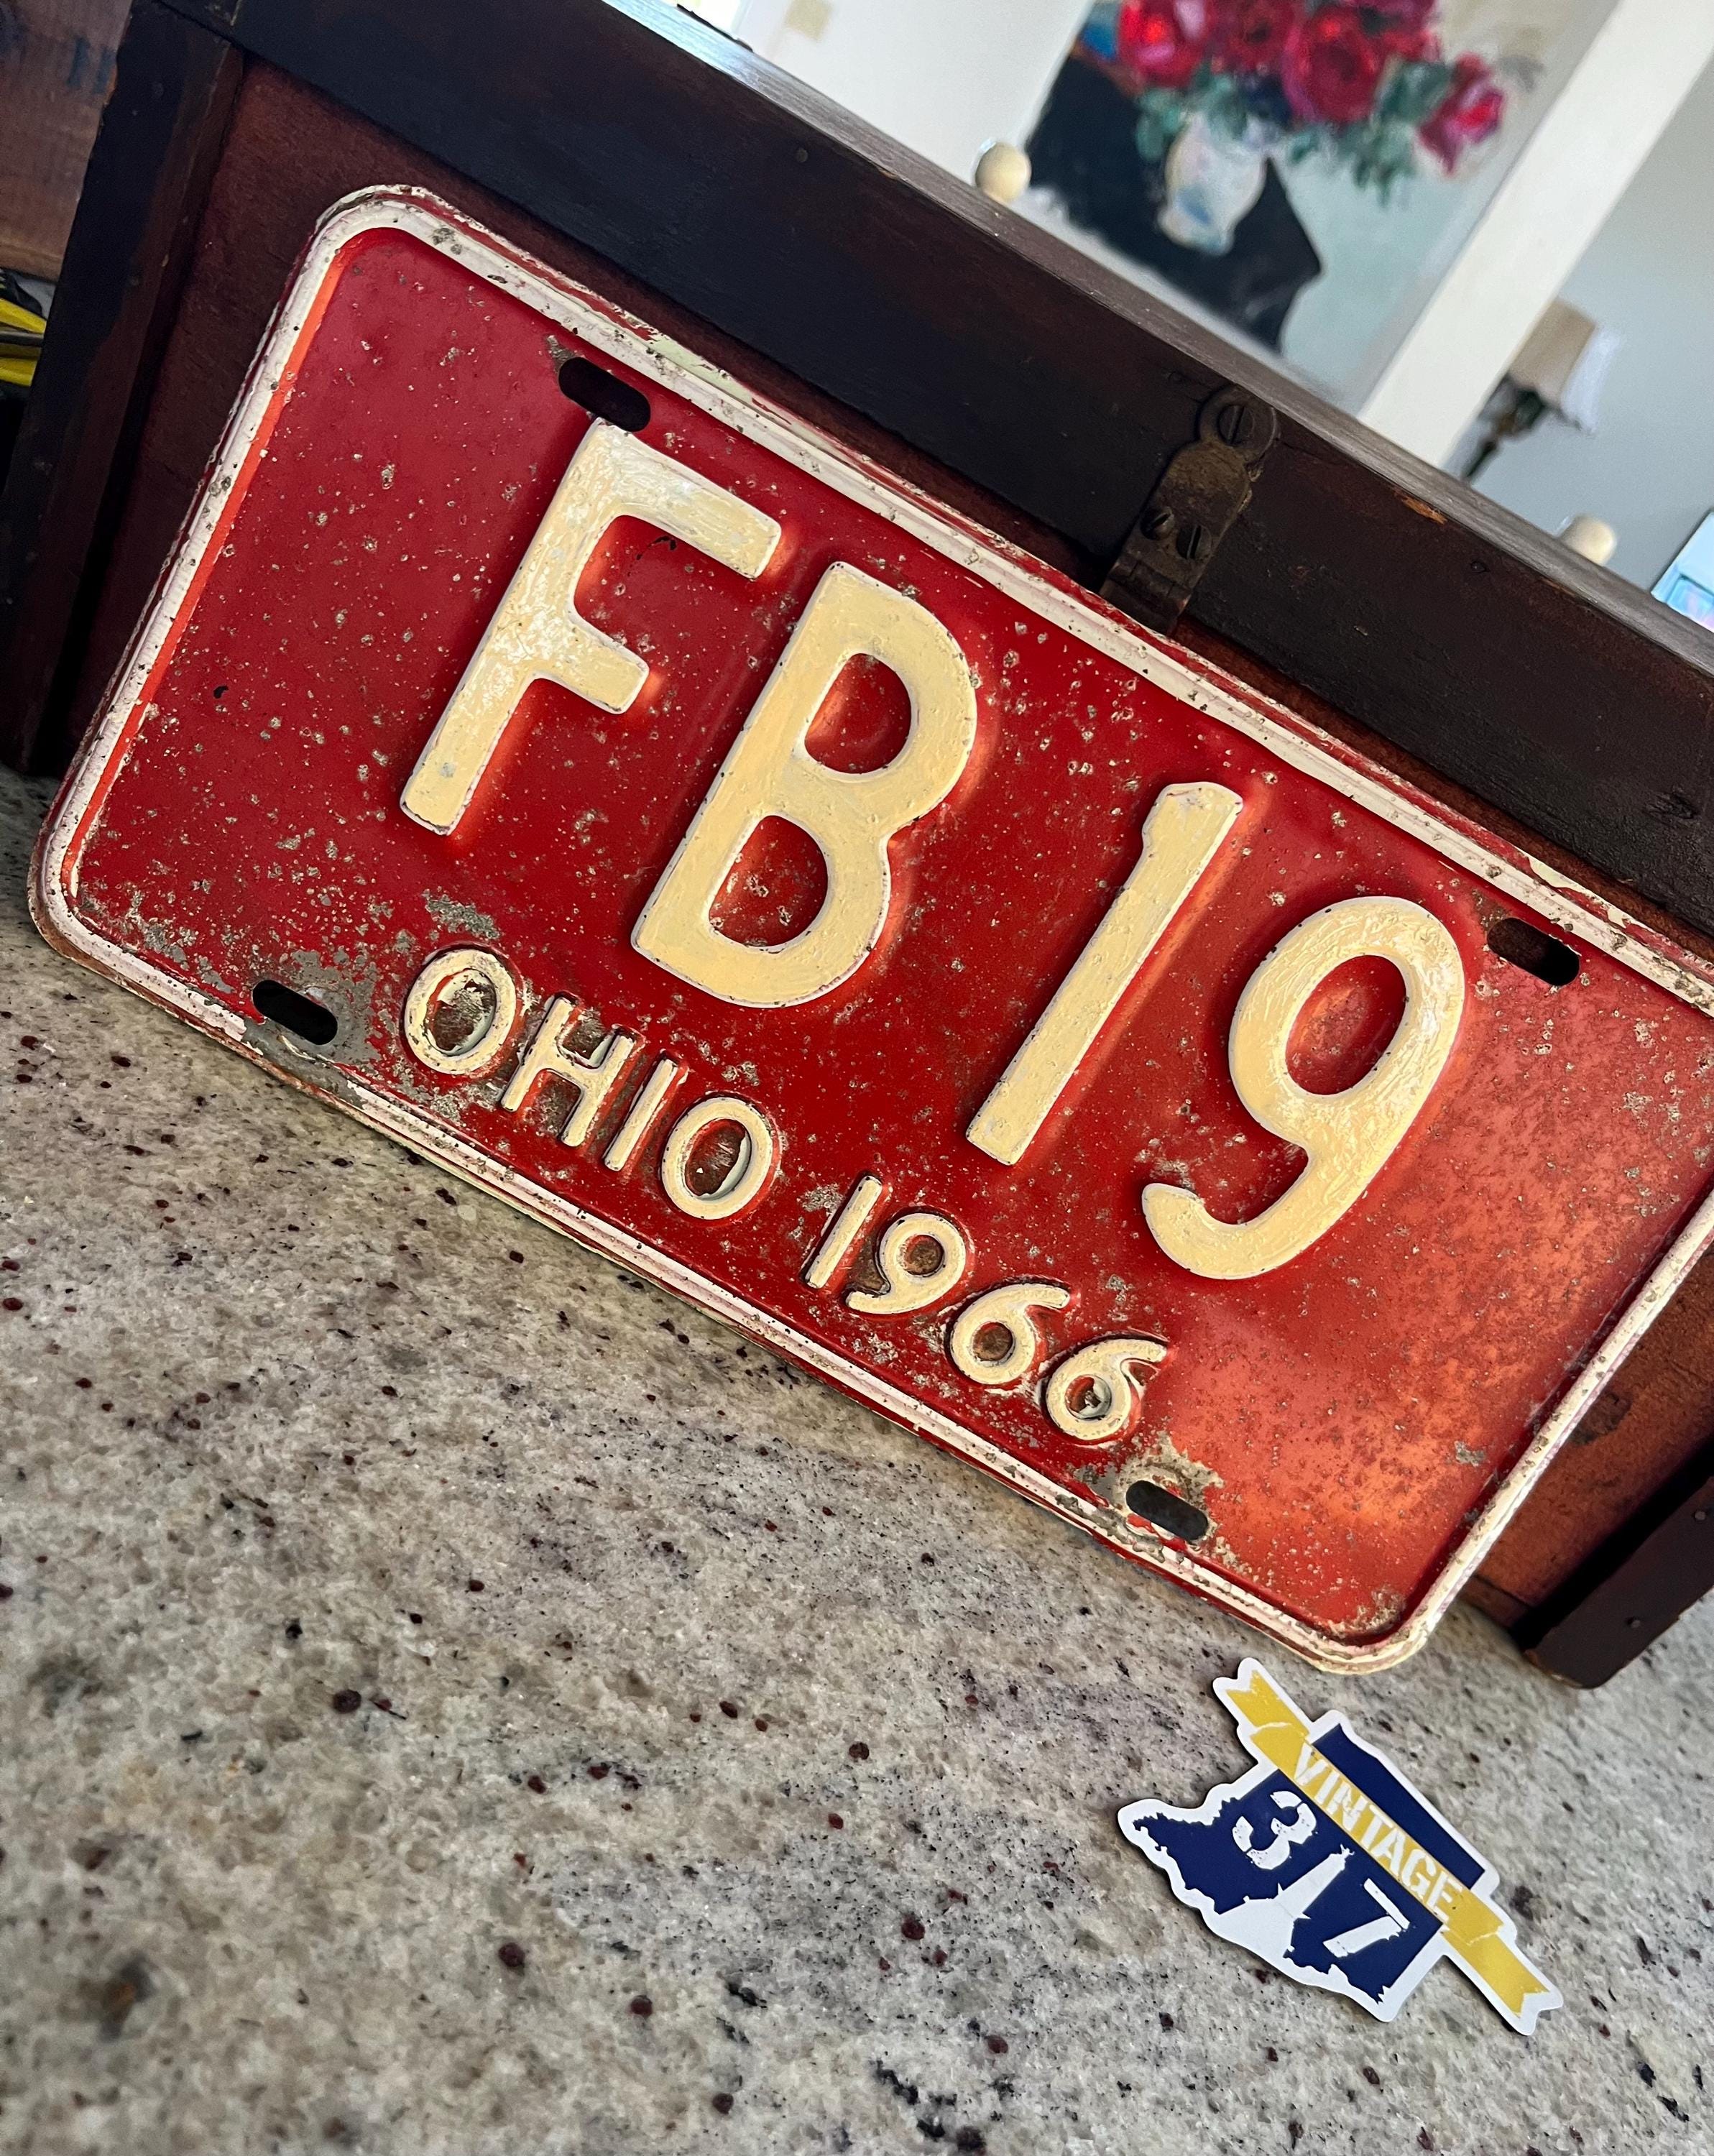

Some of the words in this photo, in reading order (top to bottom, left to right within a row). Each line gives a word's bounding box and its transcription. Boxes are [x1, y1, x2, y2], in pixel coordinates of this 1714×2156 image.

[400, 418, 977, 1007] FB
[967, 781, 1465, 1279] 19
[404, 948, 778, 1220] OHIO
[807, 1175, 1168, 1441] 1966
[1232, 1790, 1410, 1958] 317
[1291, 1745, 1463, 1923] VINTAGE
